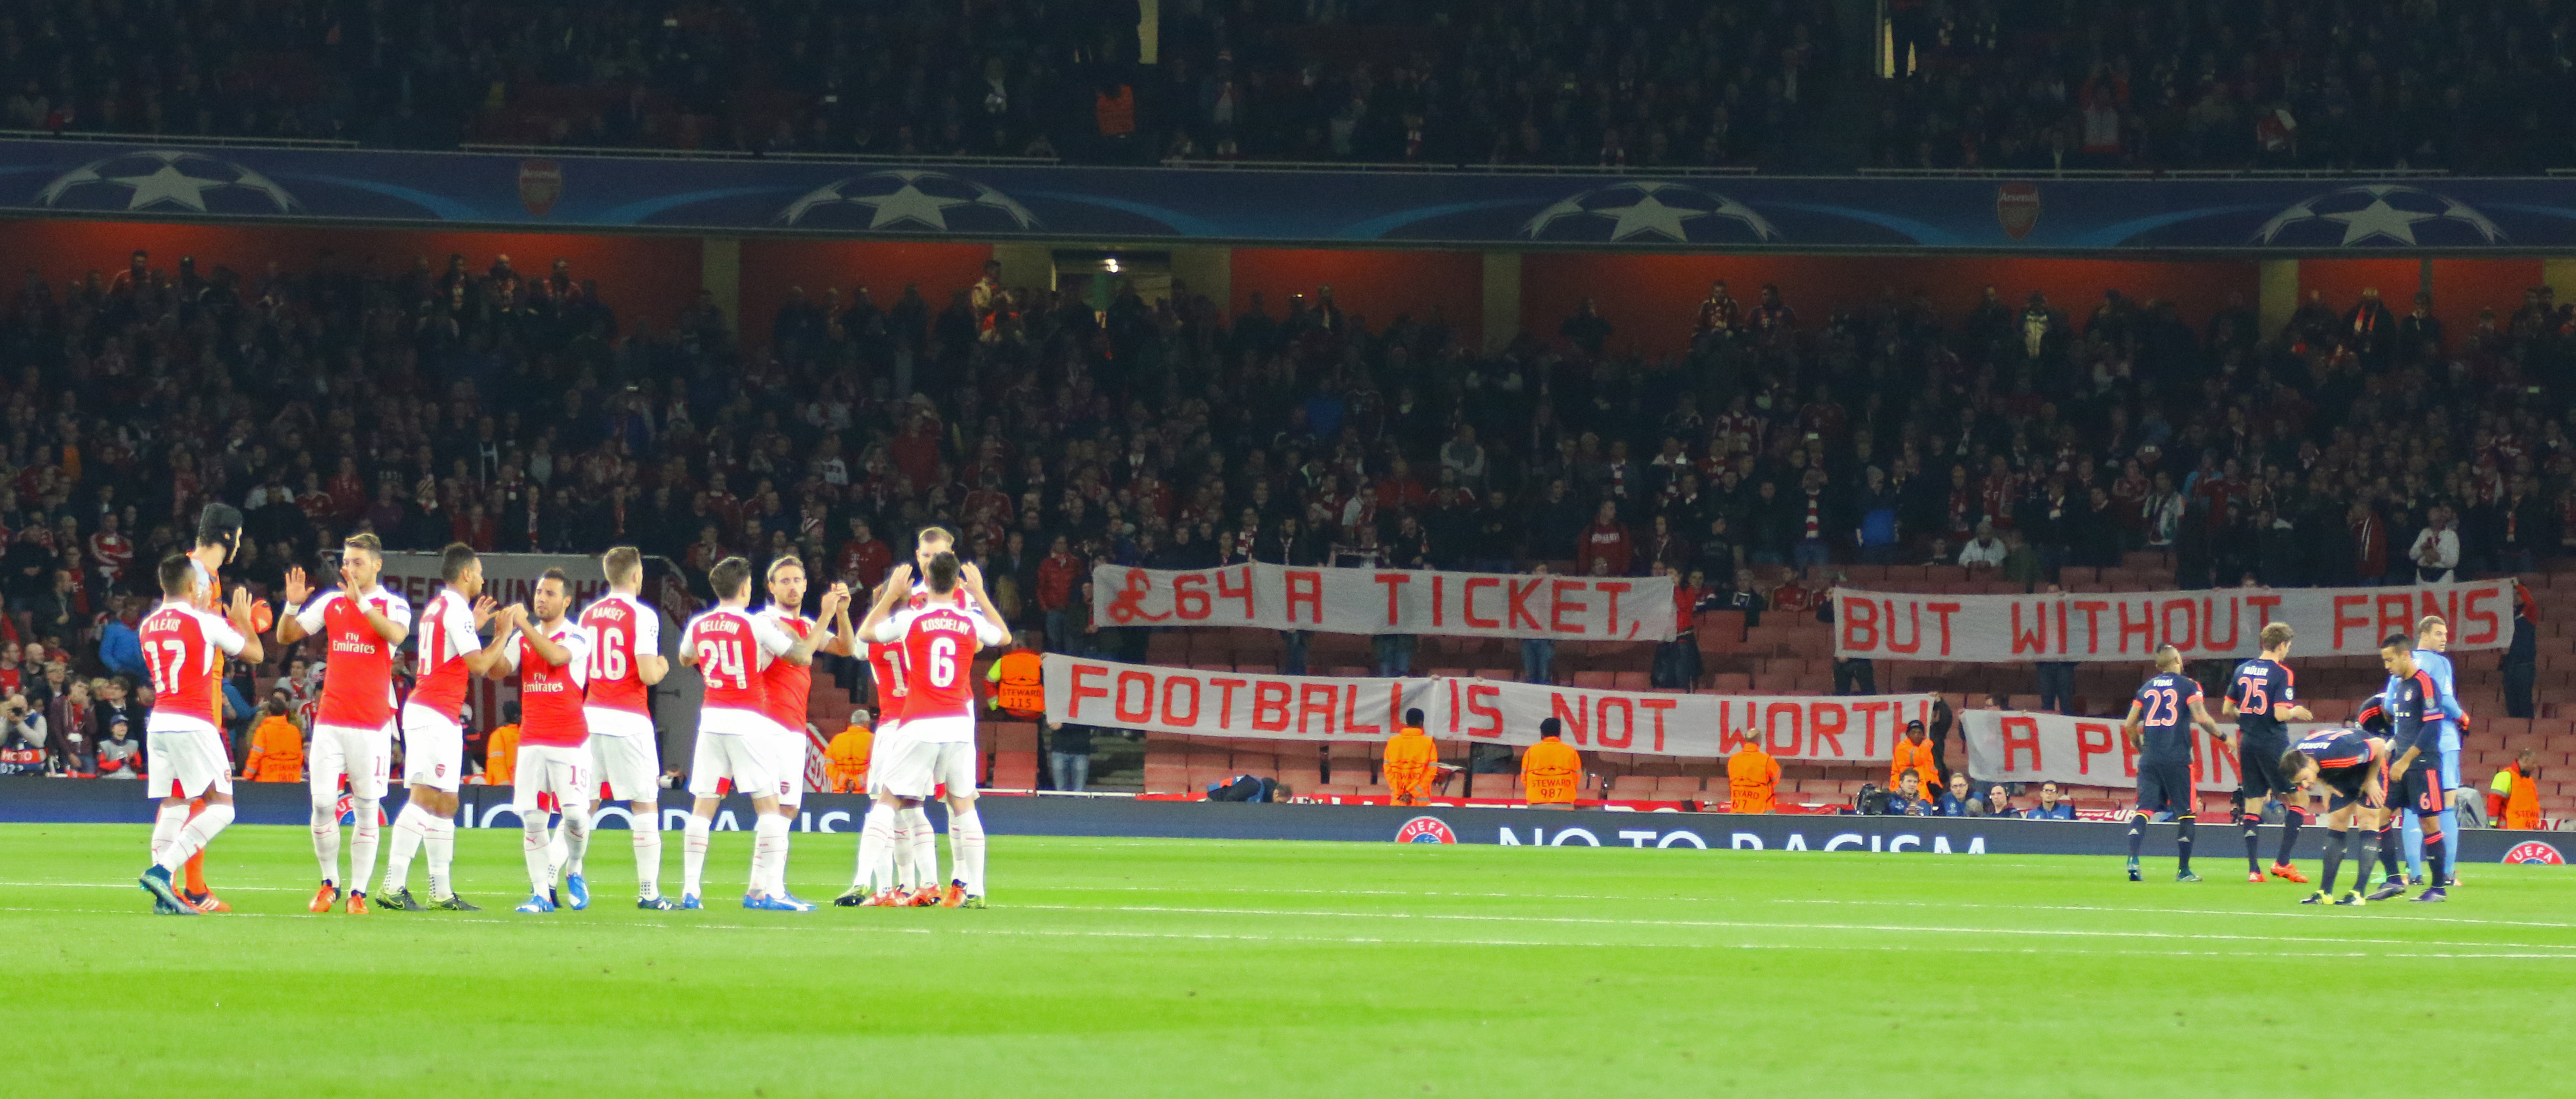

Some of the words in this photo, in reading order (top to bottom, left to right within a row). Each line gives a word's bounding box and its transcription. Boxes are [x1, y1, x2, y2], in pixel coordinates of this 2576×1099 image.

[1107, 566, 1254, 623] £64
[1285, 571, 1323, 624] A
[1374, 573, 1640, 640] TICKET,
[592, 607, 626, 622] RAMSEY
[1842, 596, 1961, 656] BUT
[2011, 595, 2282, 656] WITHOUT
[2333, 587, 2500, 650] FANS
[149, 618, 181, 633] ALEXIS
[700, 620, 740, 635] BELLERIN
[921, 618, 970, 635] KOSCIELNY
[345, 632, 360, 642] Fly
[333, 640, 375, 654] Emirates
[589, 625, 627, 680] 16
[144, 640, 187, 694] 17
[697, 640, 747, 689] 24
[930, 637, 955, 687] 6
[2242, 665, 2269, 676] MÜLLER
[534, 672, 547, 682] Fly
[2153, 679, 2173, 687] VIDAL
[523, 681, 564, 693] Emirates
[1002, 688, 1041, 697] STEWARD
[1010, 698, 1031, 708] 115
[2238, 677, 2268, 715] 25
[1068, 664, 1407, 735] FOOTBALL
[1449, 679, 1504, 739] IS
[1551, 692, 1677, 753] NOT
[1719, 699, 1928, 758] WORTH
[2144, 689, 2178, 726] 23
[2001, 717, 2042, 773] A
[2075, 722, 2317, 784] PEN
[569, 765, 587, 788] 19
[1531, 779, 1571, 787] STEWARD
[1540, 788, 1563, 798] 987
[2420, 792, 2431, 810] 6
[1407, 821, 1443, 838] UEFA
[2512, 846, 2553, 863] UEFA
